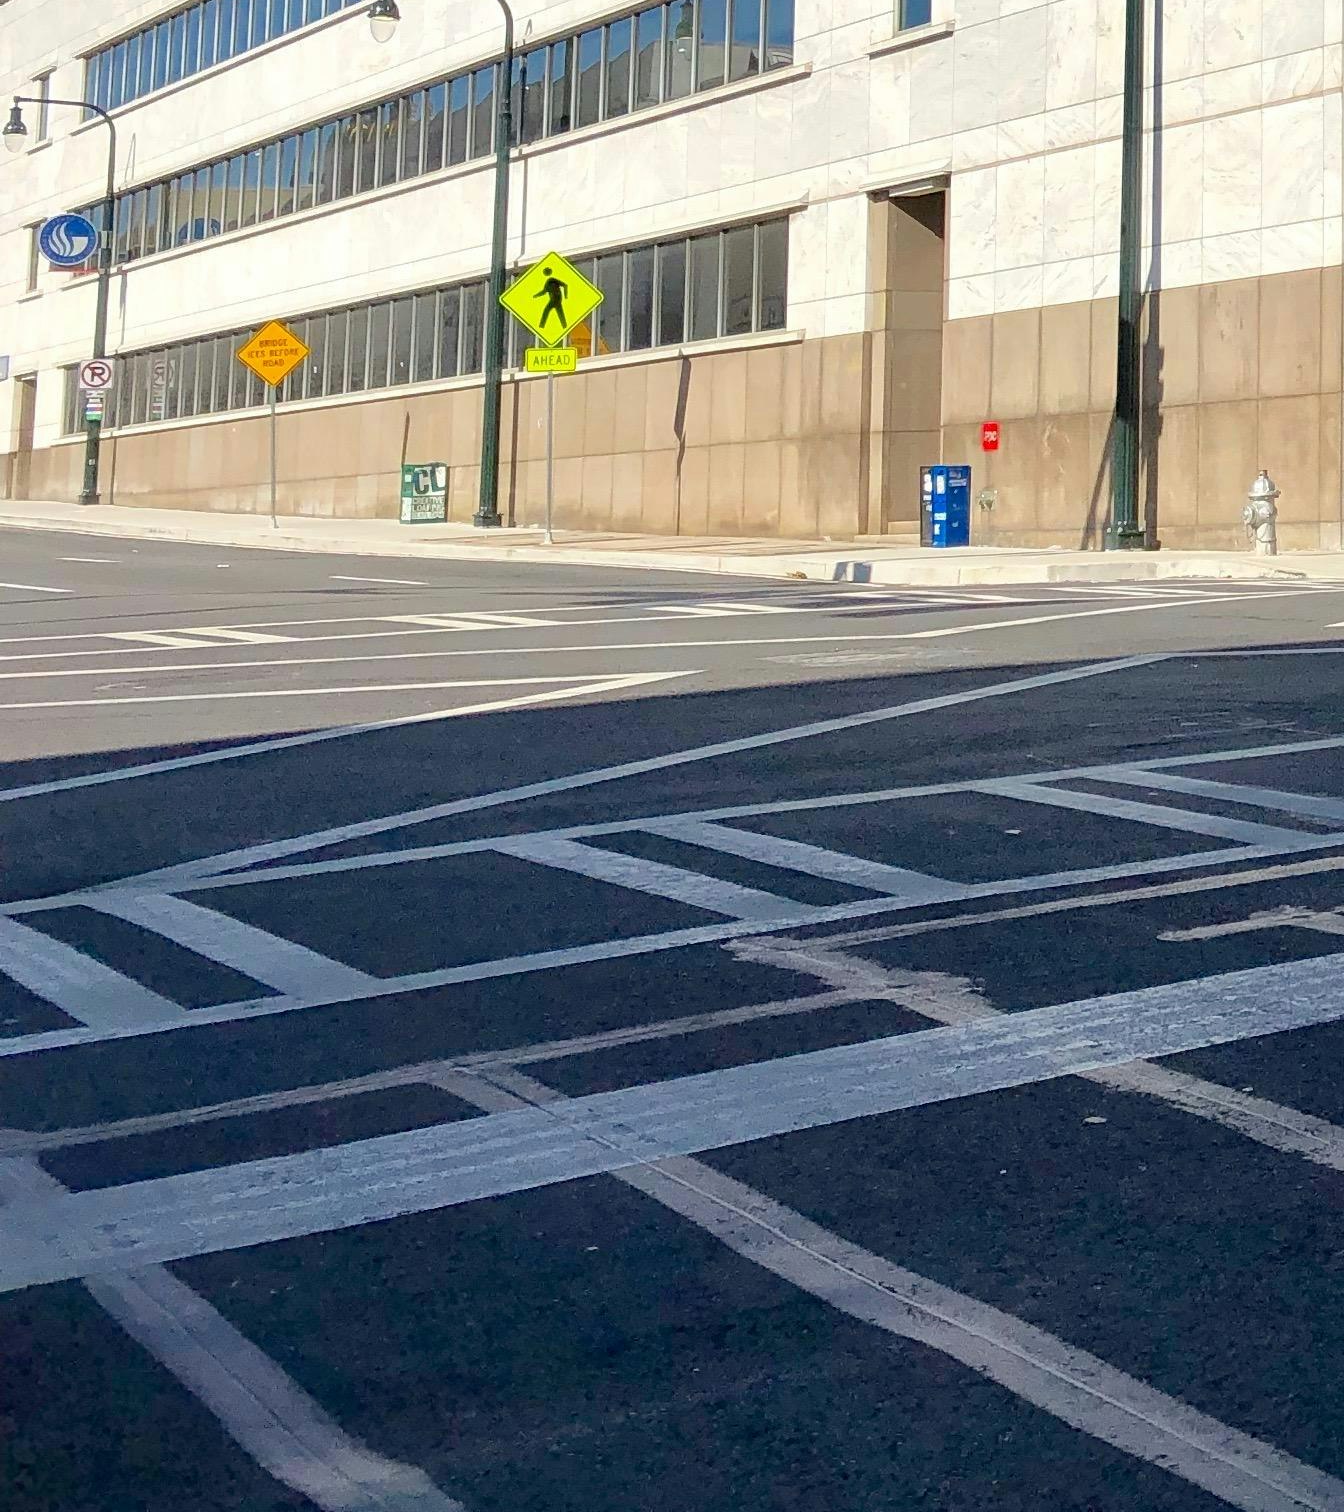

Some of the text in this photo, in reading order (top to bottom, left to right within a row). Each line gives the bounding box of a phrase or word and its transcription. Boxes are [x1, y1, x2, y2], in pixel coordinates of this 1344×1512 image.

[259, 339, 288, 348] BRIDGE
[248, 348, 299, 358] ICES BEFORE
[262, 359, 285, 367] ROAD
[533, 355, 571, 366] AHEAD
